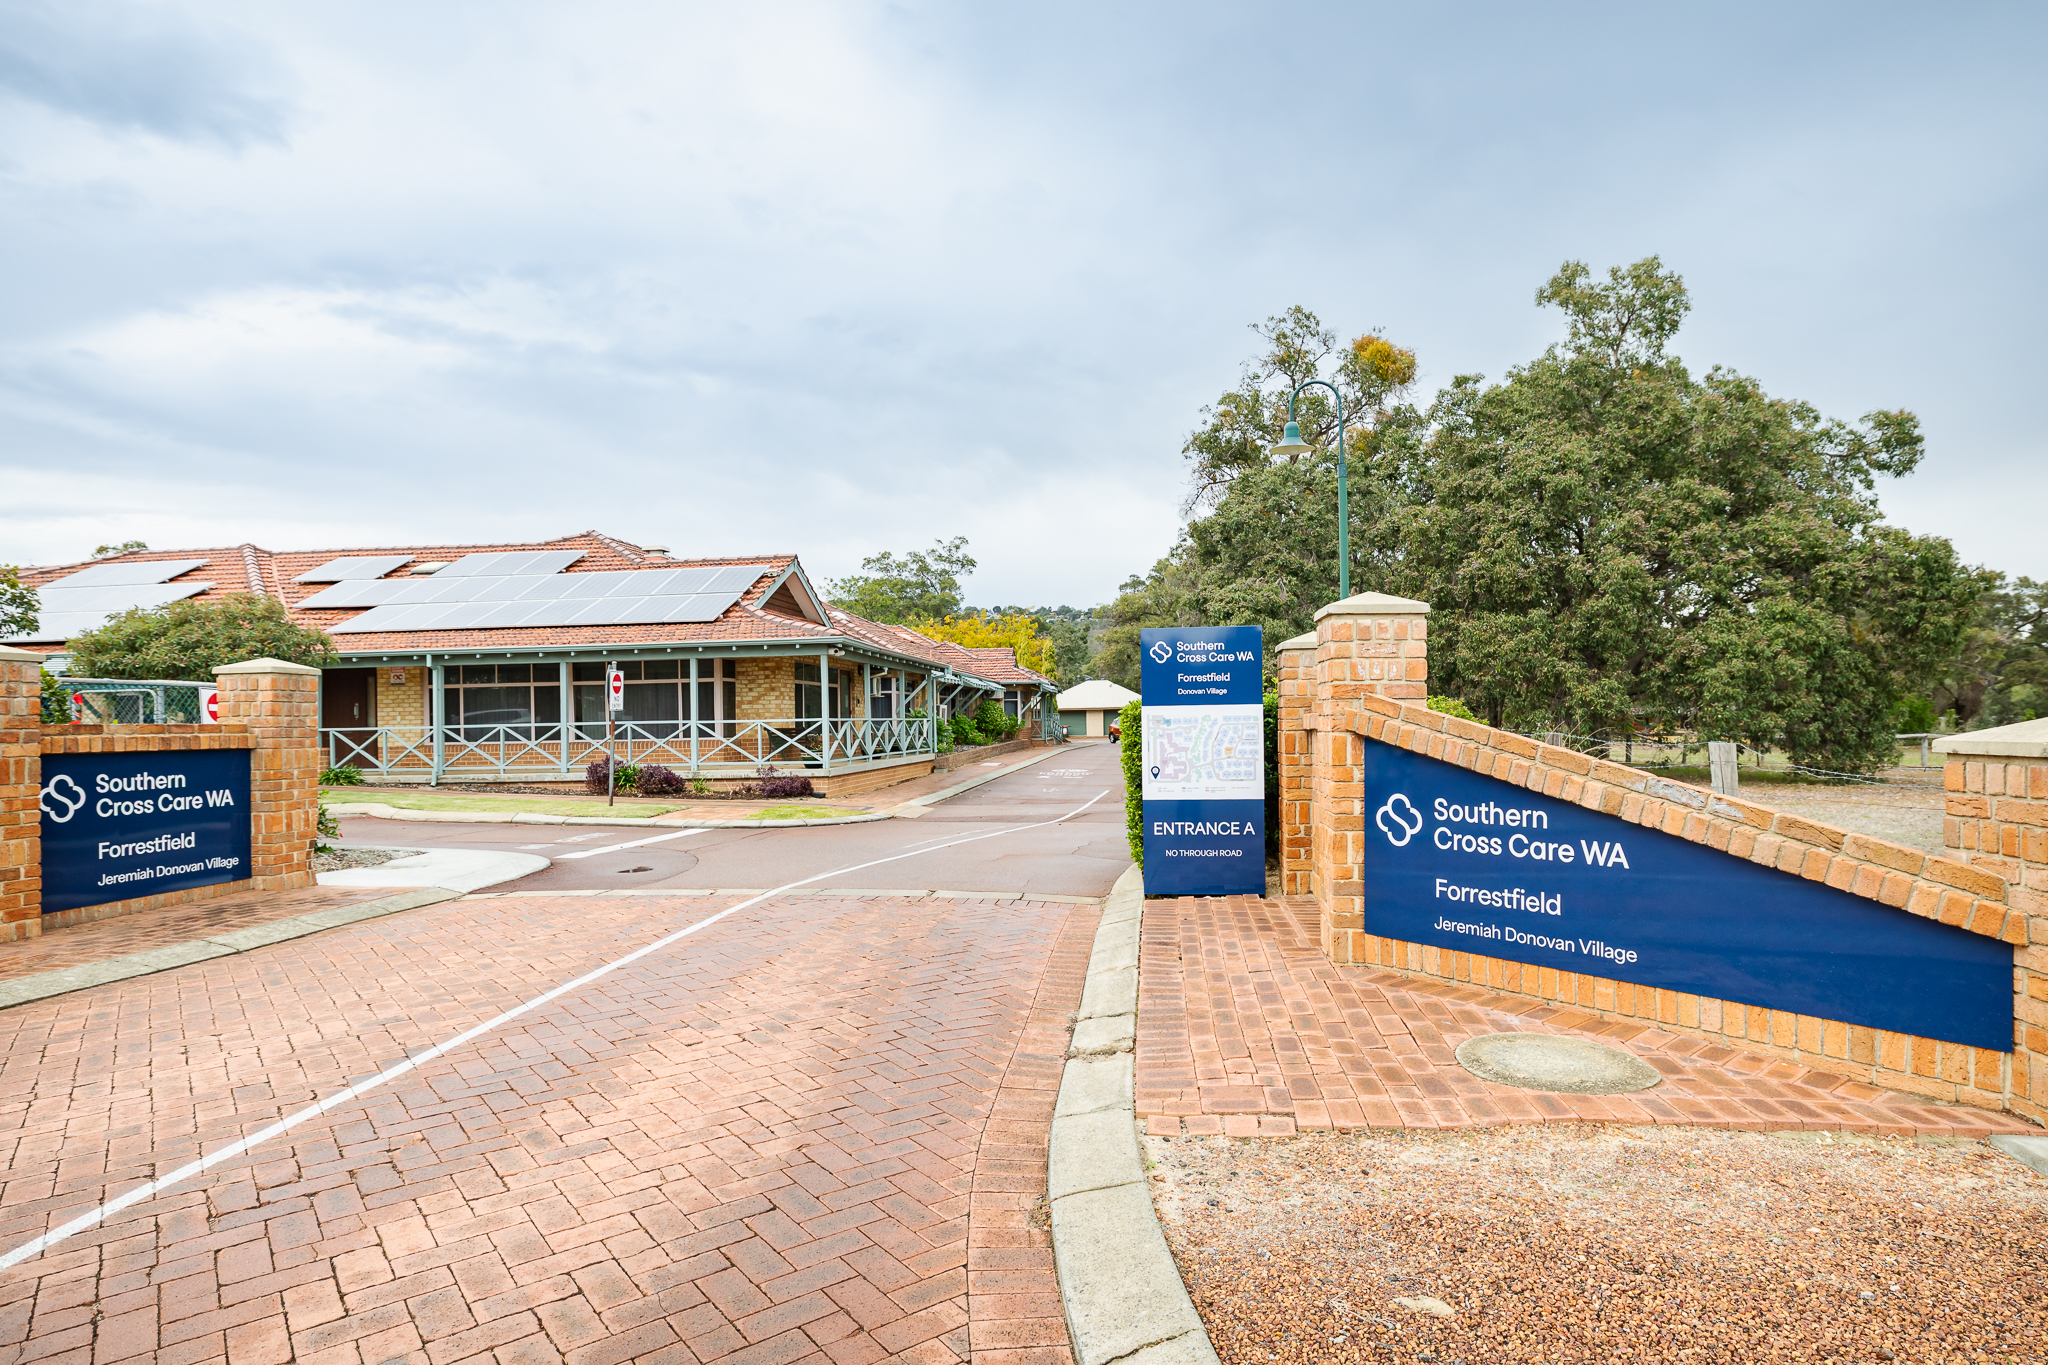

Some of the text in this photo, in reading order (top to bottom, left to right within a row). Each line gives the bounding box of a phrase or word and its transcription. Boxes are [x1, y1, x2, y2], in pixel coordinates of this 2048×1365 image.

[1177, 641, 1224, 651] Southern
[1177, 651, 1254, 662] Cross Care WA
[1178, 673, 1230, 682] Forrestfield
[1206, 688, 1227, 696] Village
[96, 772, 185, 793] Southern
[97, 790, 234, 817] Cross Care WA
[1434, 798, 1547, 829] Southern
[1154, 822, 1255, 835] ENTRANCE A
[99, 832, 195, 859] Forrestfield
[1434, 827, 1629, 869] Cross Care WA
[98, 857, 239, 886] Jeremiah Donovan Village
[1436, 879, 1561, 916] Forrestfield
[1434, 916, 1637, 964] Jeremiah Donovan Village
